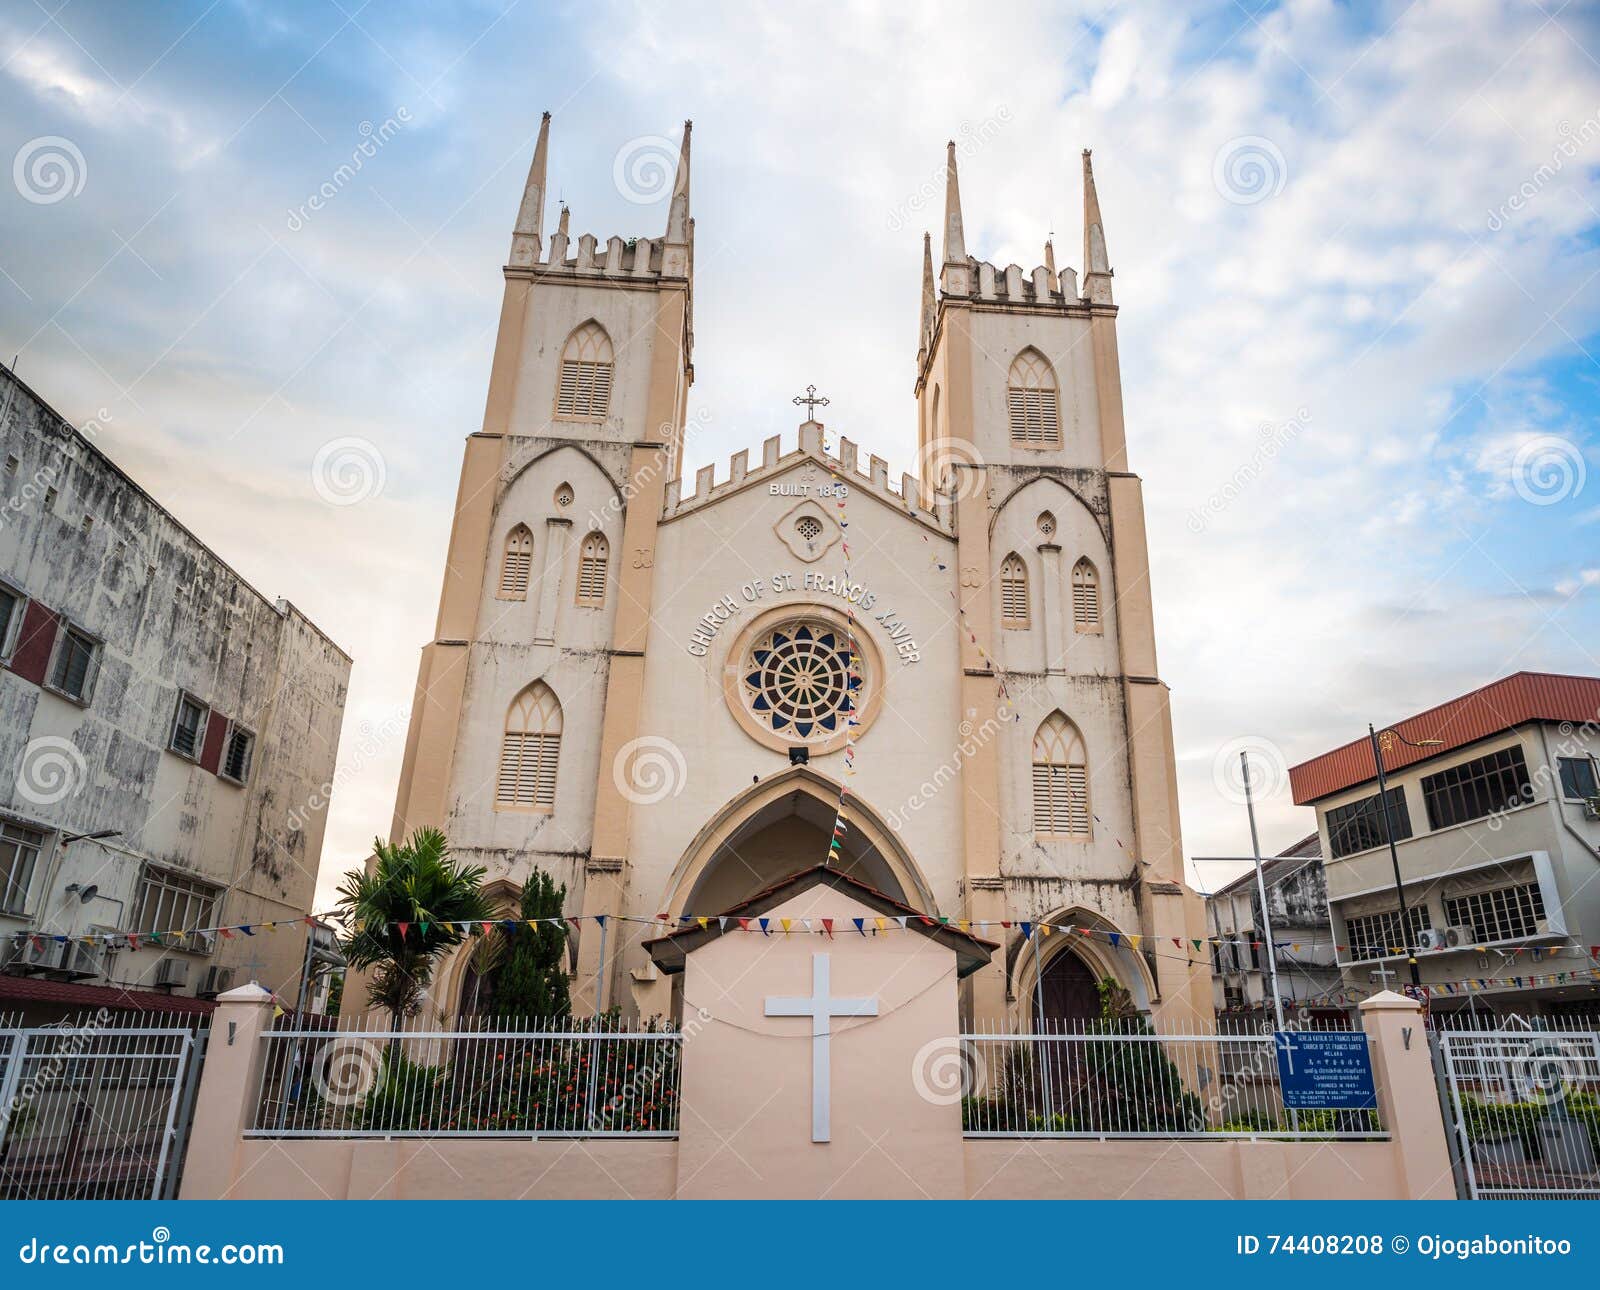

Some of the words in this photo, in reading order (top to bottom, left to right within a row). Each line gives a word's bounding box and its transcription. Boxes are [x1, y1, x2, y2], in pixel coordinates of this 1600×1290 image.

[769, 483, 810, 497] BUILT
[687, 595, 739, 657] CHURCH
[741, 580, 763, 602] OF
[772, 572, 796, 593] ST.
[804, 572, 876, 611] FRANCIS
[875, 608, 921, 665] XAVIER
